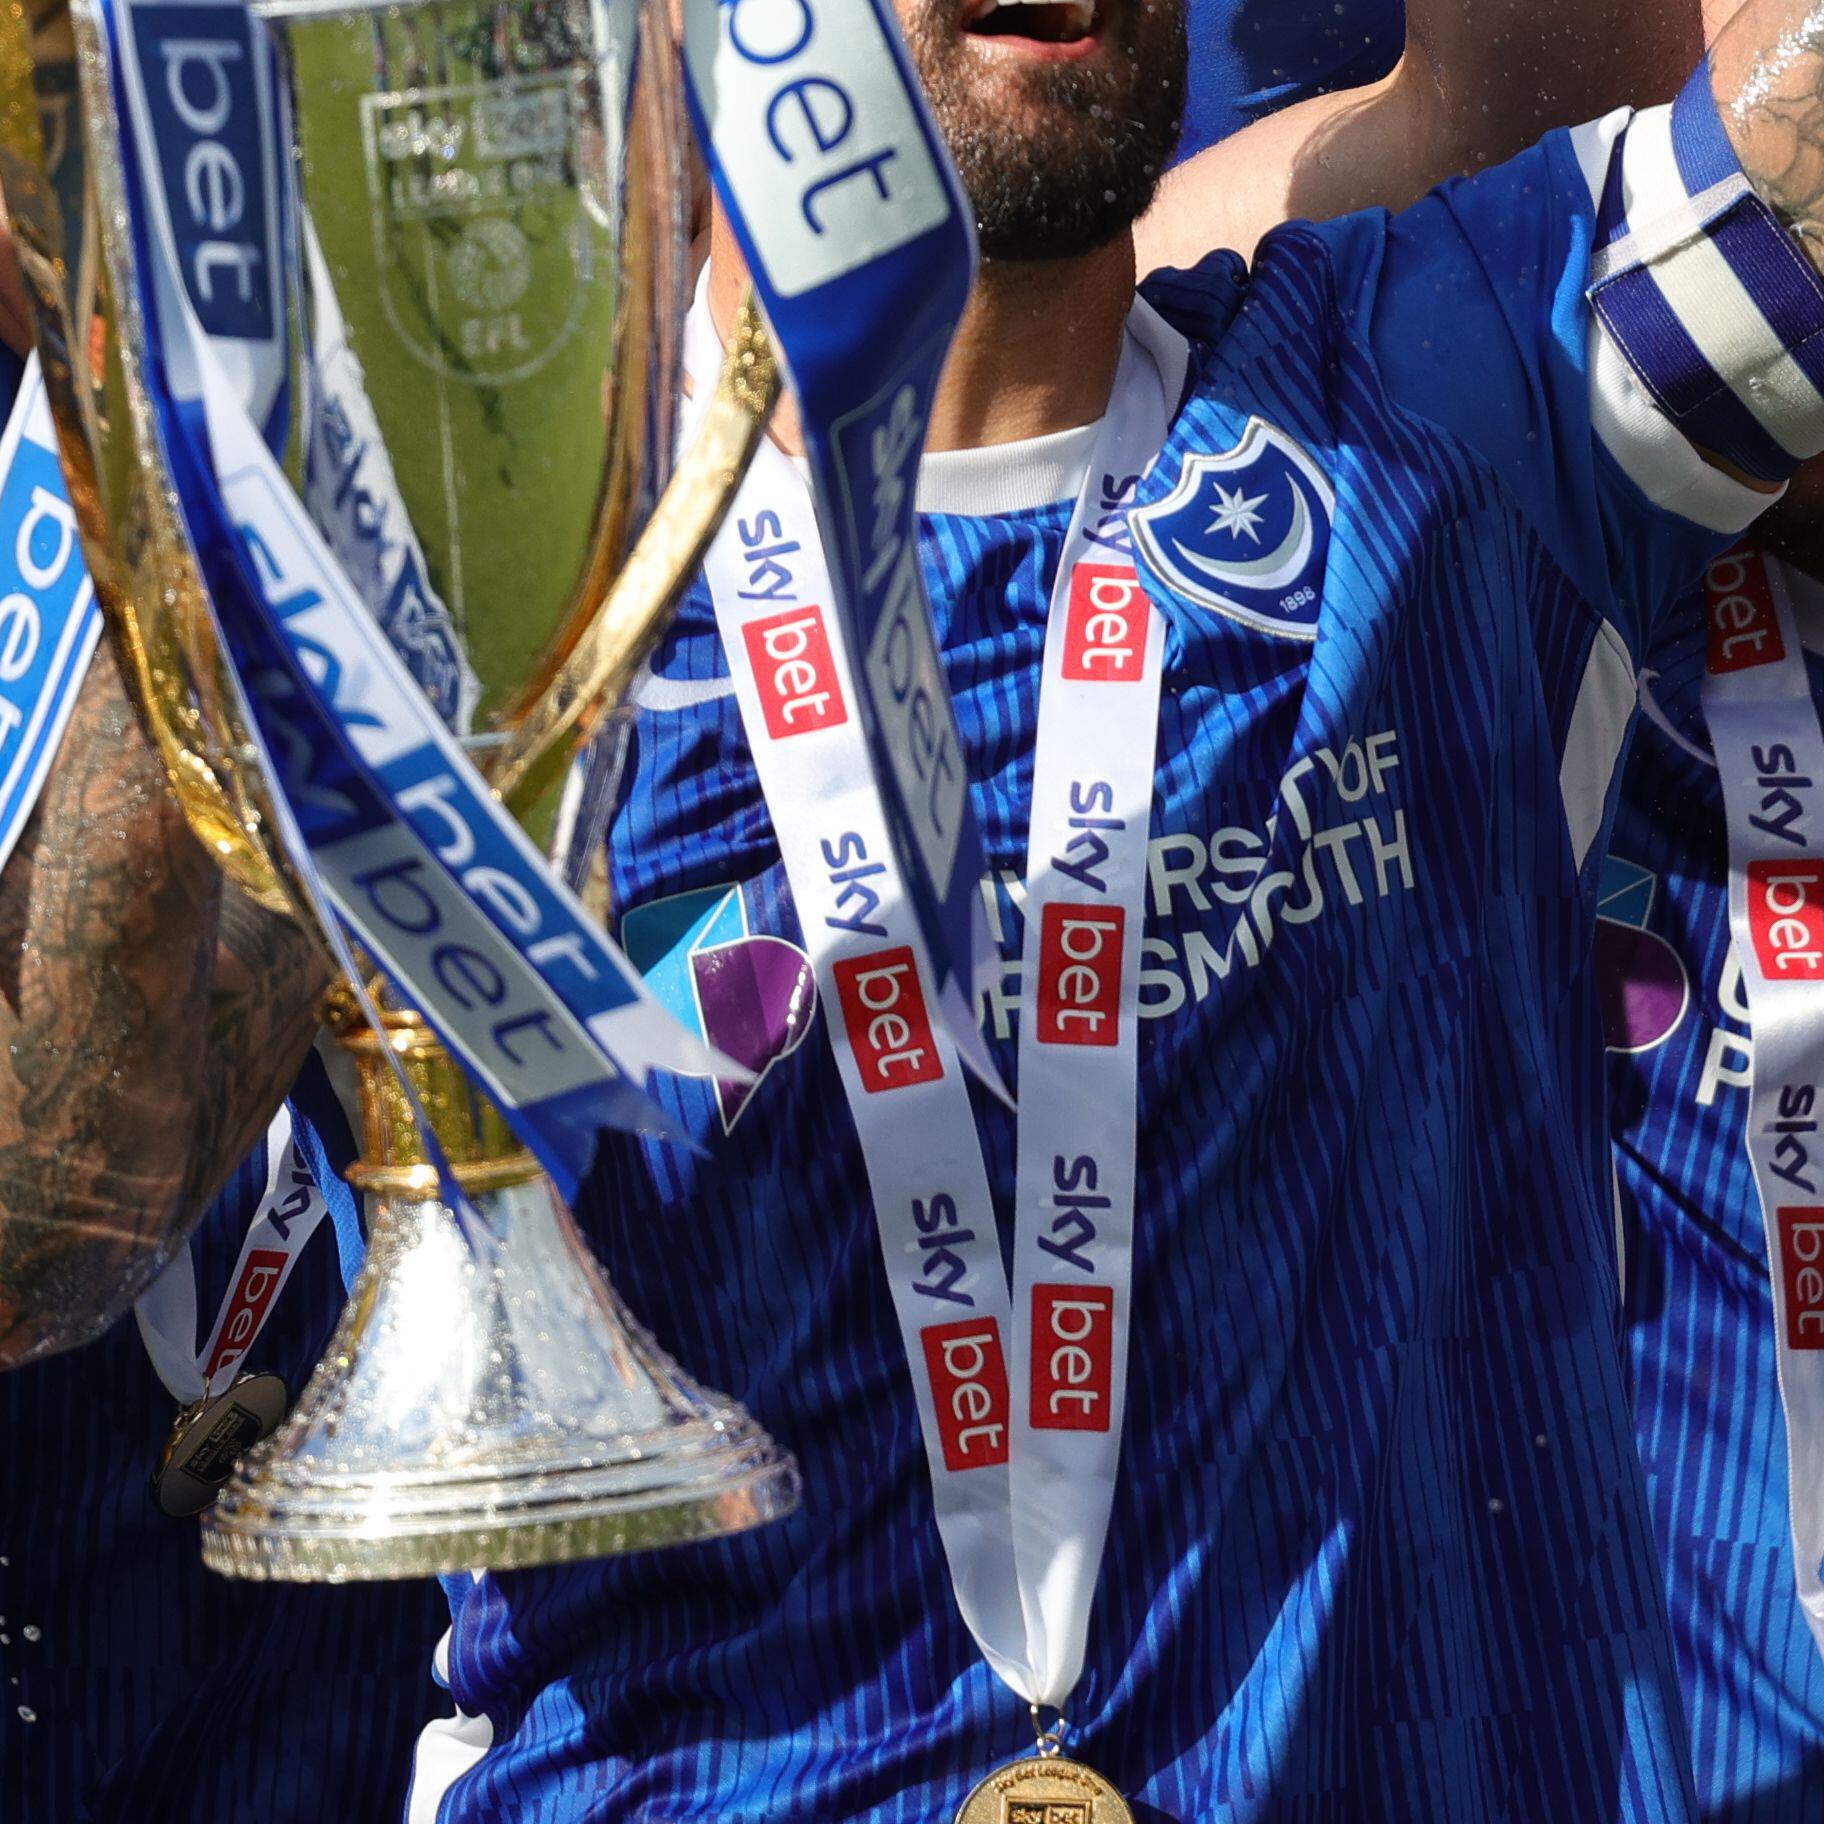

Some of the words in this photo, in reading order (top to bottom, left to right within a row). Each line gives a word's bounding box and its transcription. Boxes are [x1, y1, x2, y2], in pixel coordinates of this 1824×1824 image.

[159, 38, 261, 302] bet
[737, 508, 801, 601] sky
[1278, 584, 1317, 615] 1898
[1707, 550, 1768, 660] bet
[762, 616, 831, 725] bet
[1081, 576, 1140, 670] bet
[882, 580, 955, 838] bet
[1050, 780, 1127, 894] sky
[1748, 742, 1813, 848] sky
[820, 831, 889, 938] sky
[1764, 875, 1823, 971] bet
[354, 857, 566, 1067] bet
[1055, 918, 1118, 1034] bet
[854, 962, 926, 1079] bet
[1768, 1083, 1819, 1195] sky
[911, 1192, 976, 1308] sky
[1036, 1154, 1112, 1274] sky
[941, 1333, 1004, 1455] bet
[1048, 1299, 1107, 1415] bet
